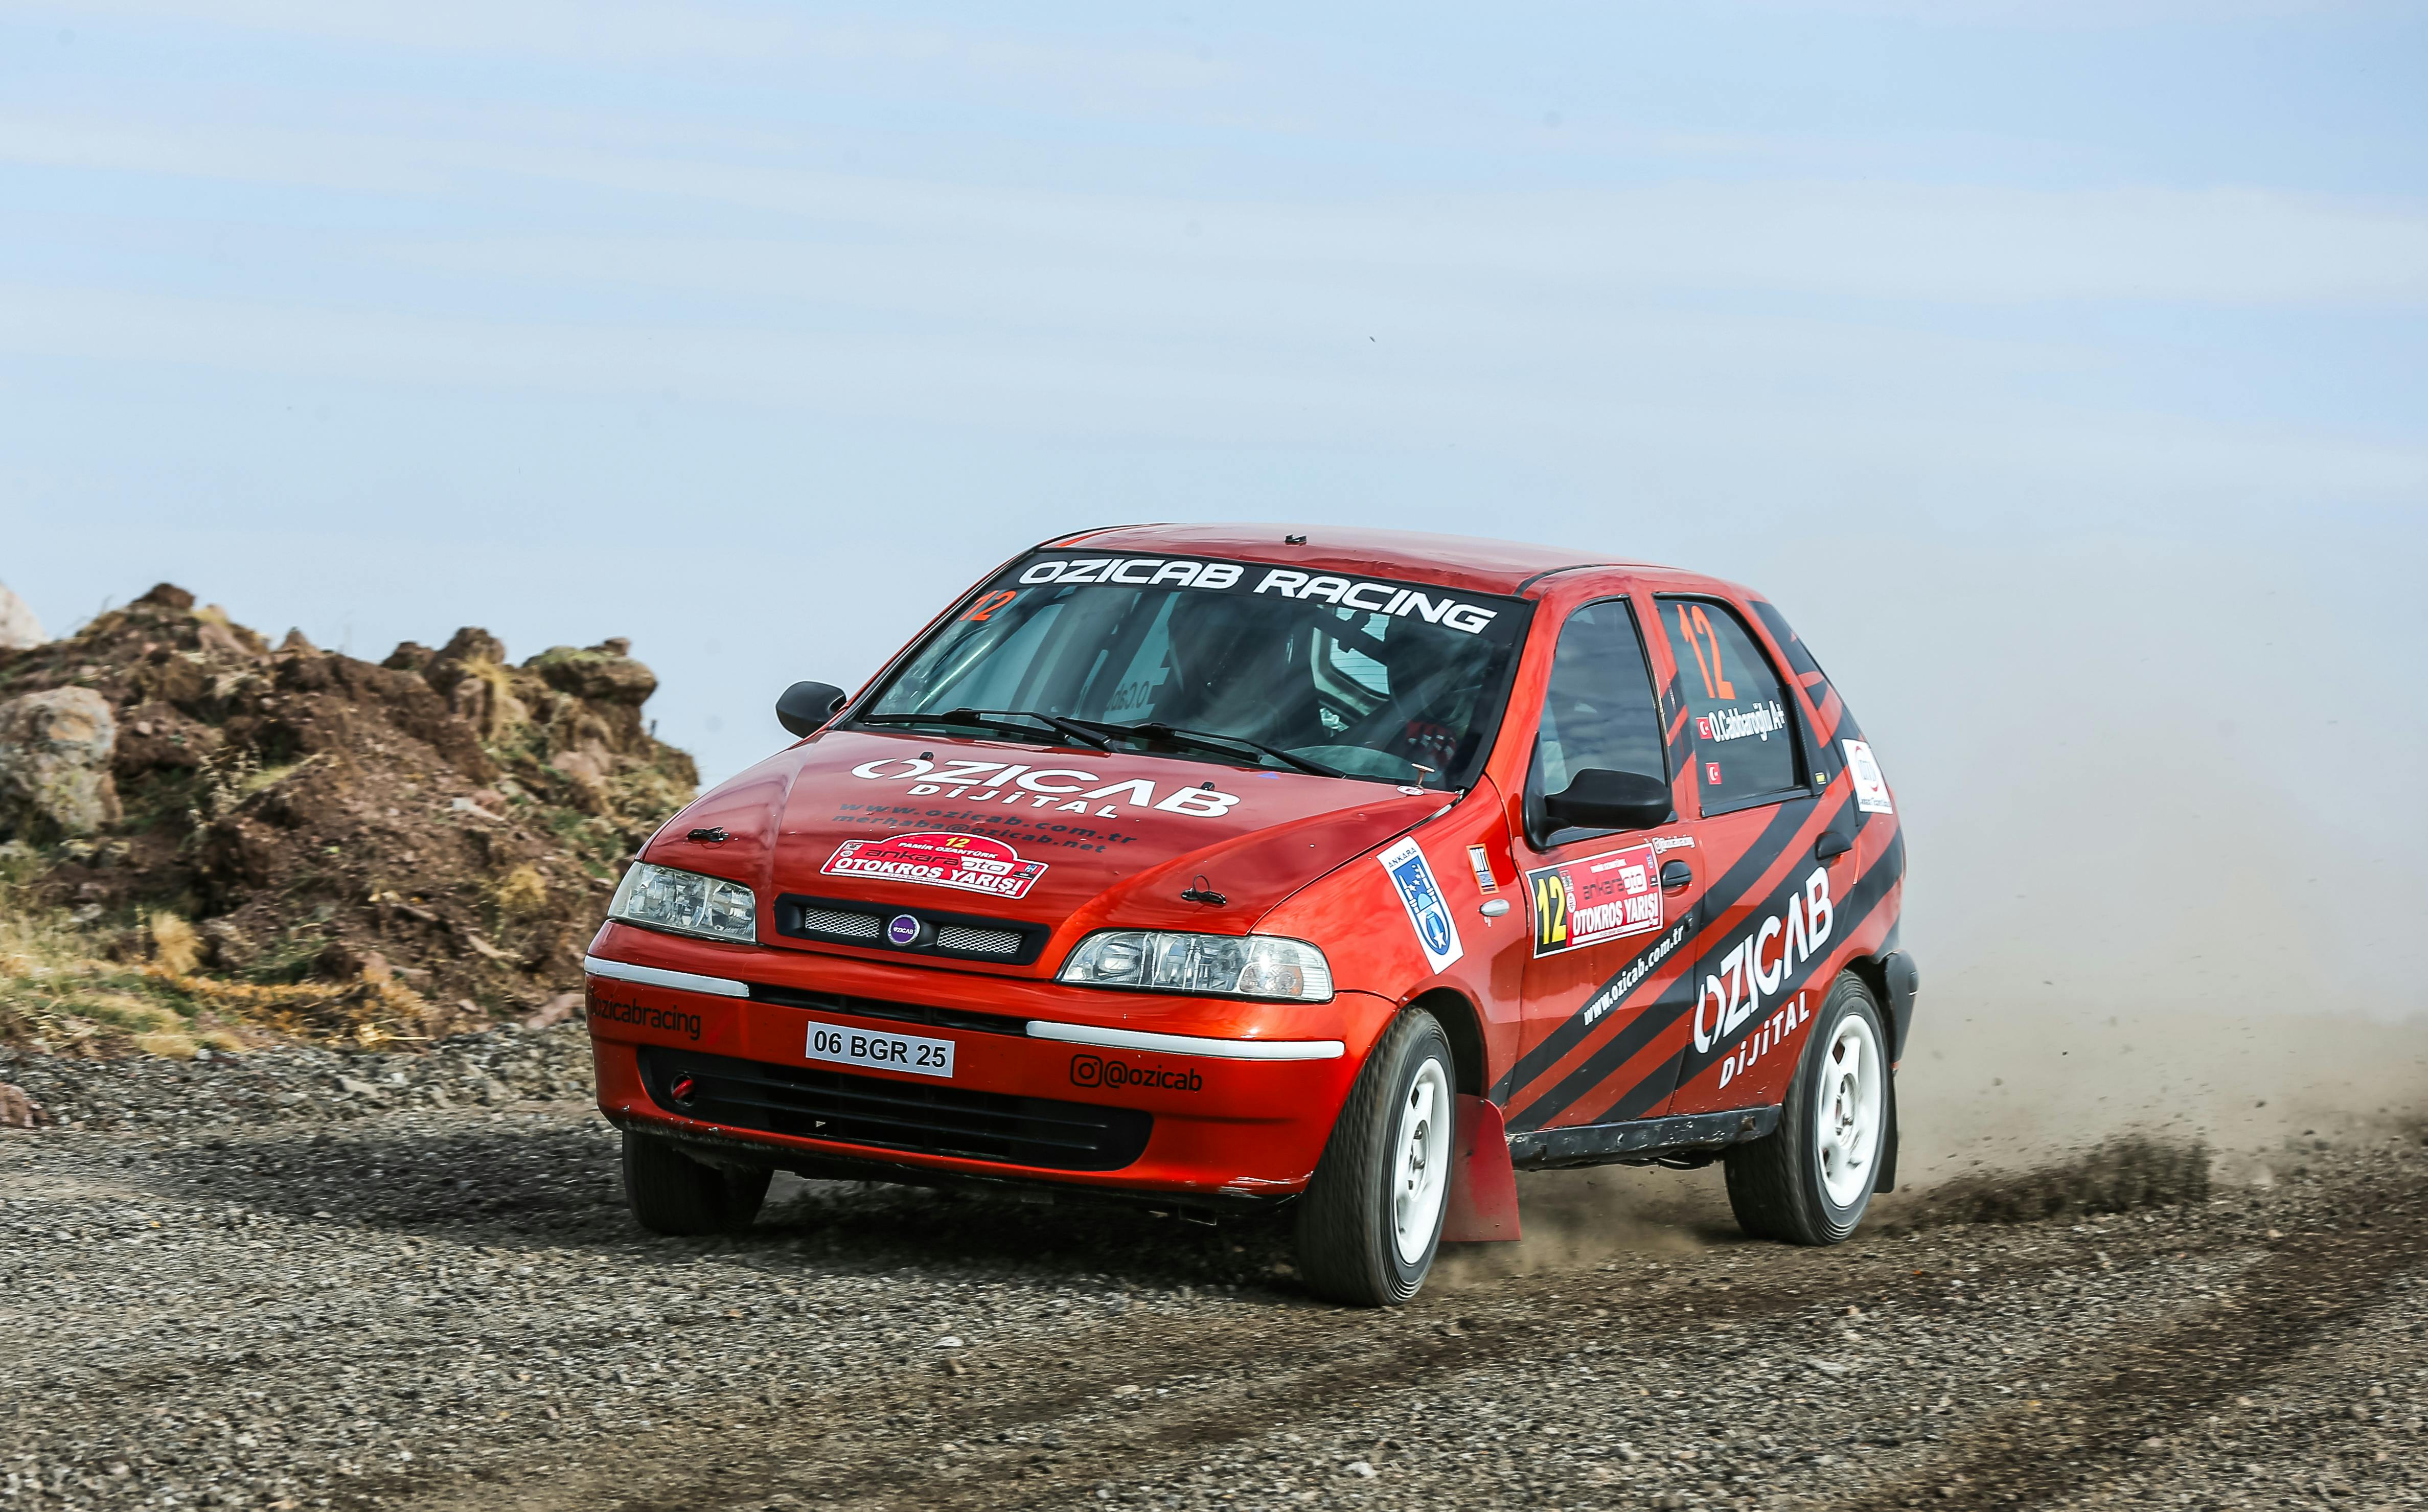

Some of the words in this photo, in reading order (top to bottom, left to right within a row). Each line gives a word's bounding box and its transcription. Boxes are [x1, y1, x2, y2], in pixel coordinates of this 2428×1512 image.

[959, 590, 1017, 621] 12
[1019, 558, 1244, 590] OZICAB
[1253, 569, 1498, 634] RACING
[1677, 604, 1736, 700] 12
[851, 758, 1241, 818] OZICAB
[831, 813, 1108, 854] merhaba@ozicab.net
[839, 803, 1138, 845] www.ozicab.com.tr
[945, 837, 971, 849] 12
[834, 858, 945, 879] OTOKROS
[950, 869, 1023, 892] YARIŞI
[1388, 846, 1417, 868] ANKARA
[1537, 875, 1567, 945] 12
[1572, 900, 1623, 936] OTOKROS
[1584, 924, 1684, 1026] www.ozicab.com.tr
[1693, 865, 1834, 1054] OZICAB
[814, 1030, 842, 1054] 06
[850, 1035, 908, 1064] BGR
[915, 1044, 946, 1068] 25
[1104, 1060, 1203, 1091] @ozicab
